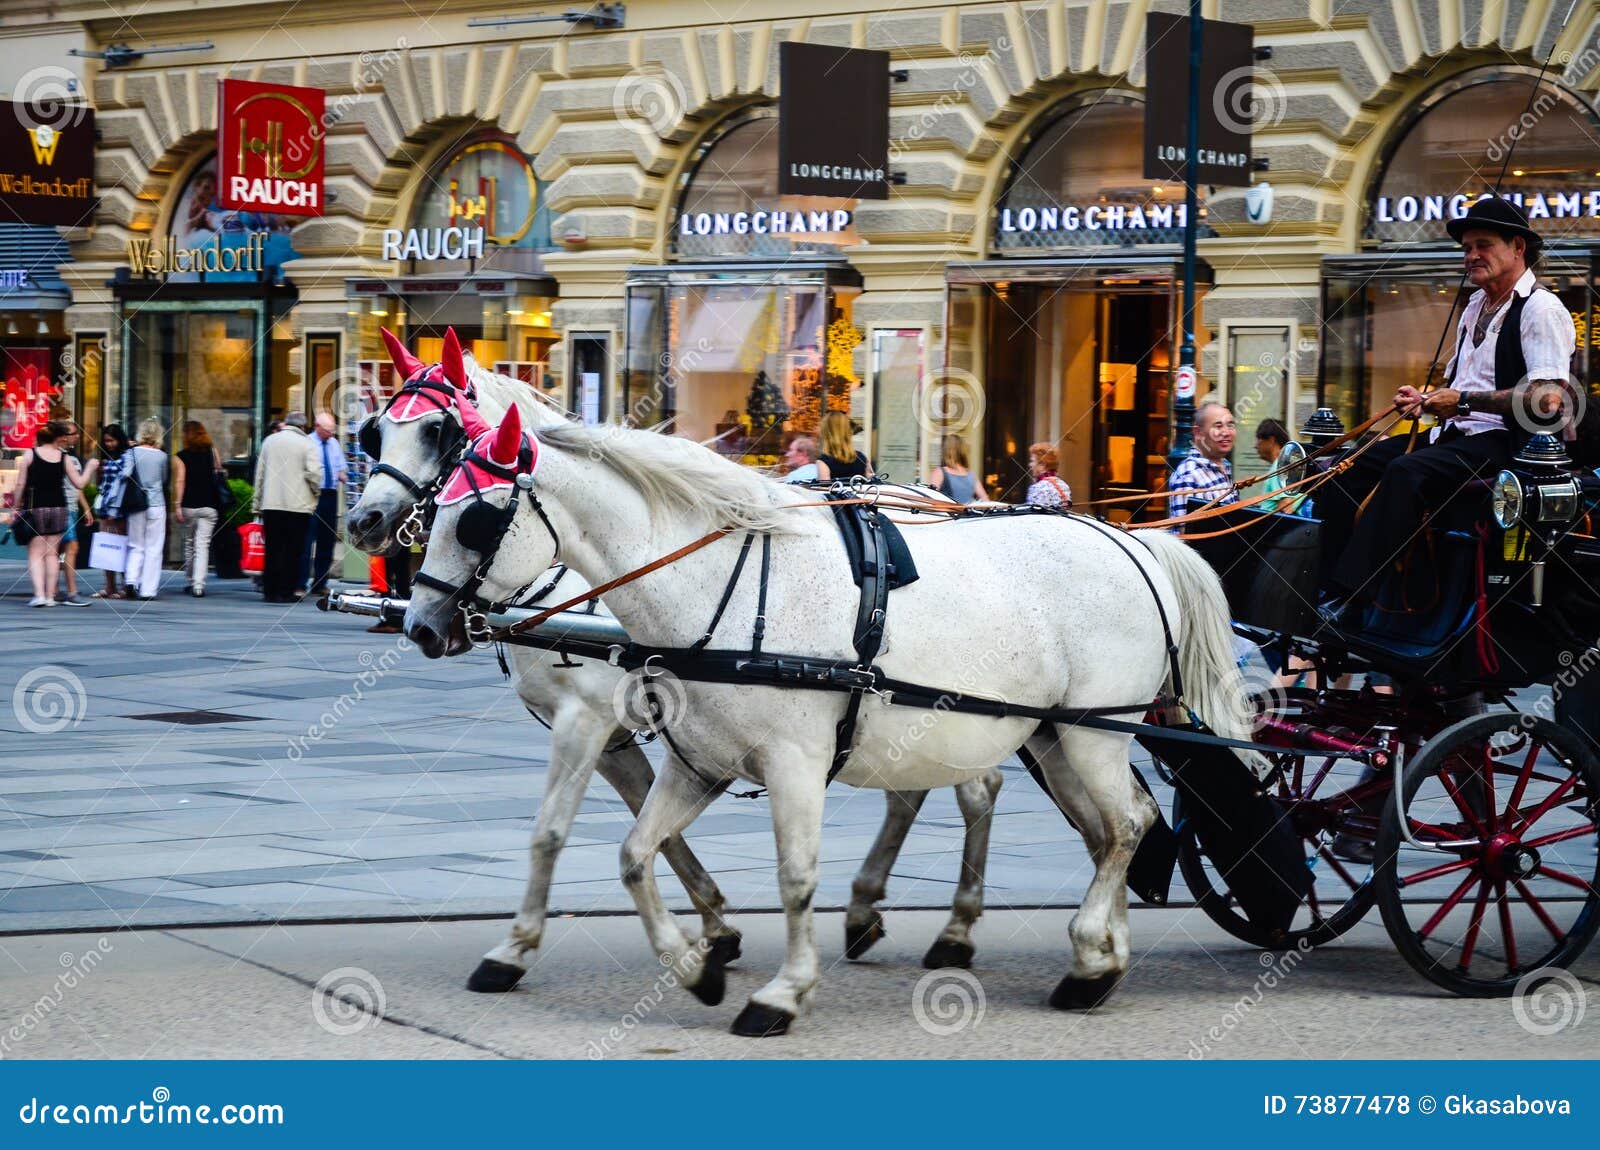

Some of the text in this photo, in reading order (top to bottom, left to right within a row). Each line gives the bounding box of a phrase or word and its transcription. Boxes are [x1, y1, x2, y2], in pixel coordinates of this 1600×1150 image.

[1158, 145, 1247, 167] LONCHAMP
[0, 173, 91, 198] Wellendorff
[790, 163, 884, 182] LONGCHAMP
[230, 176, 318, 207] RAUCH
[681, 209, 850, 236] LONGCHAMP
[127, 231, 268, 274] Wellendorff
[382, 226, 484, 261] RAUCH
